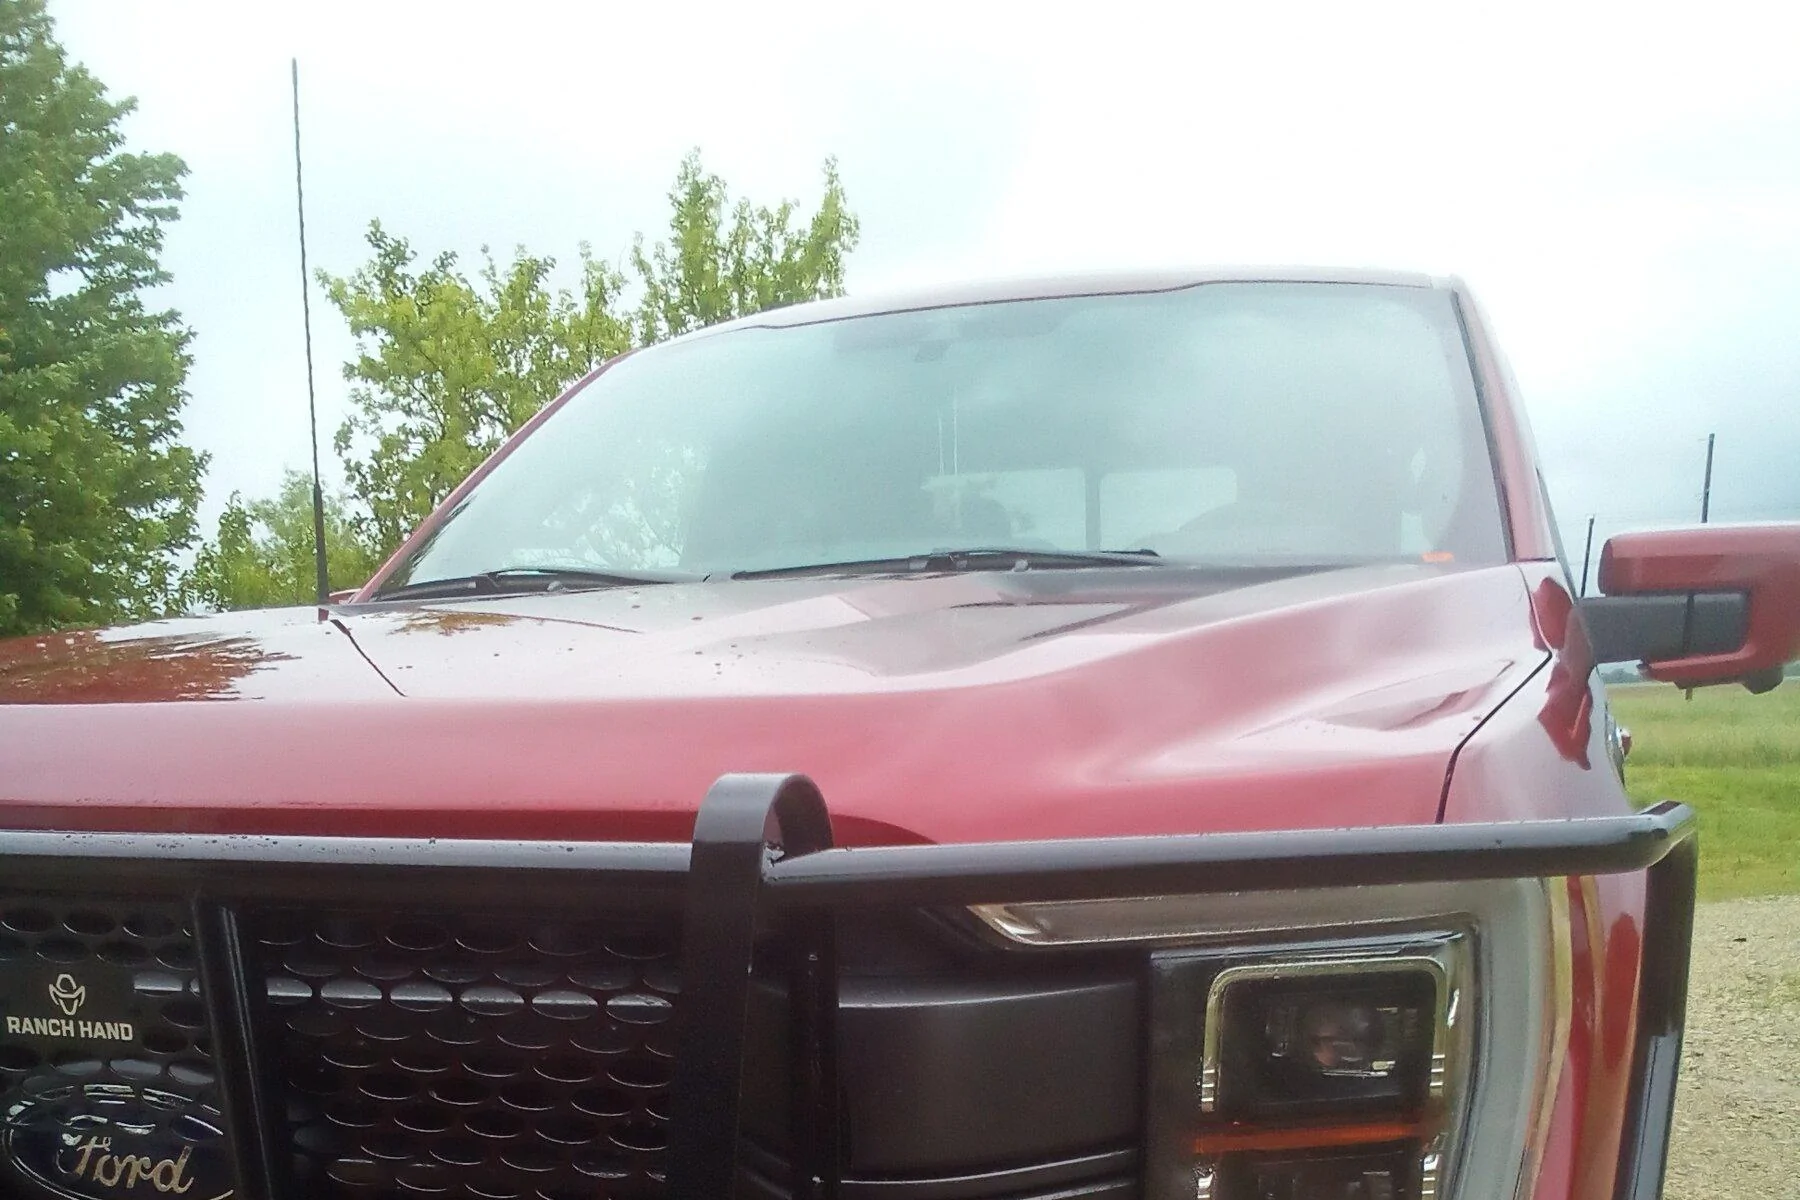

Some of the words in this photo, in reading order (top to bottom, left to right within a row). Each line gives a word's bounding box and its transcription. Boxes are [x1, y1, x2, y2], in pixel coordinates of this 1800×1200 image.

[6, 1016, 75, 1038] RANCH
[79, 1020, 133, 1041] HAND
[56, 1133, 195, 1194] Ford
